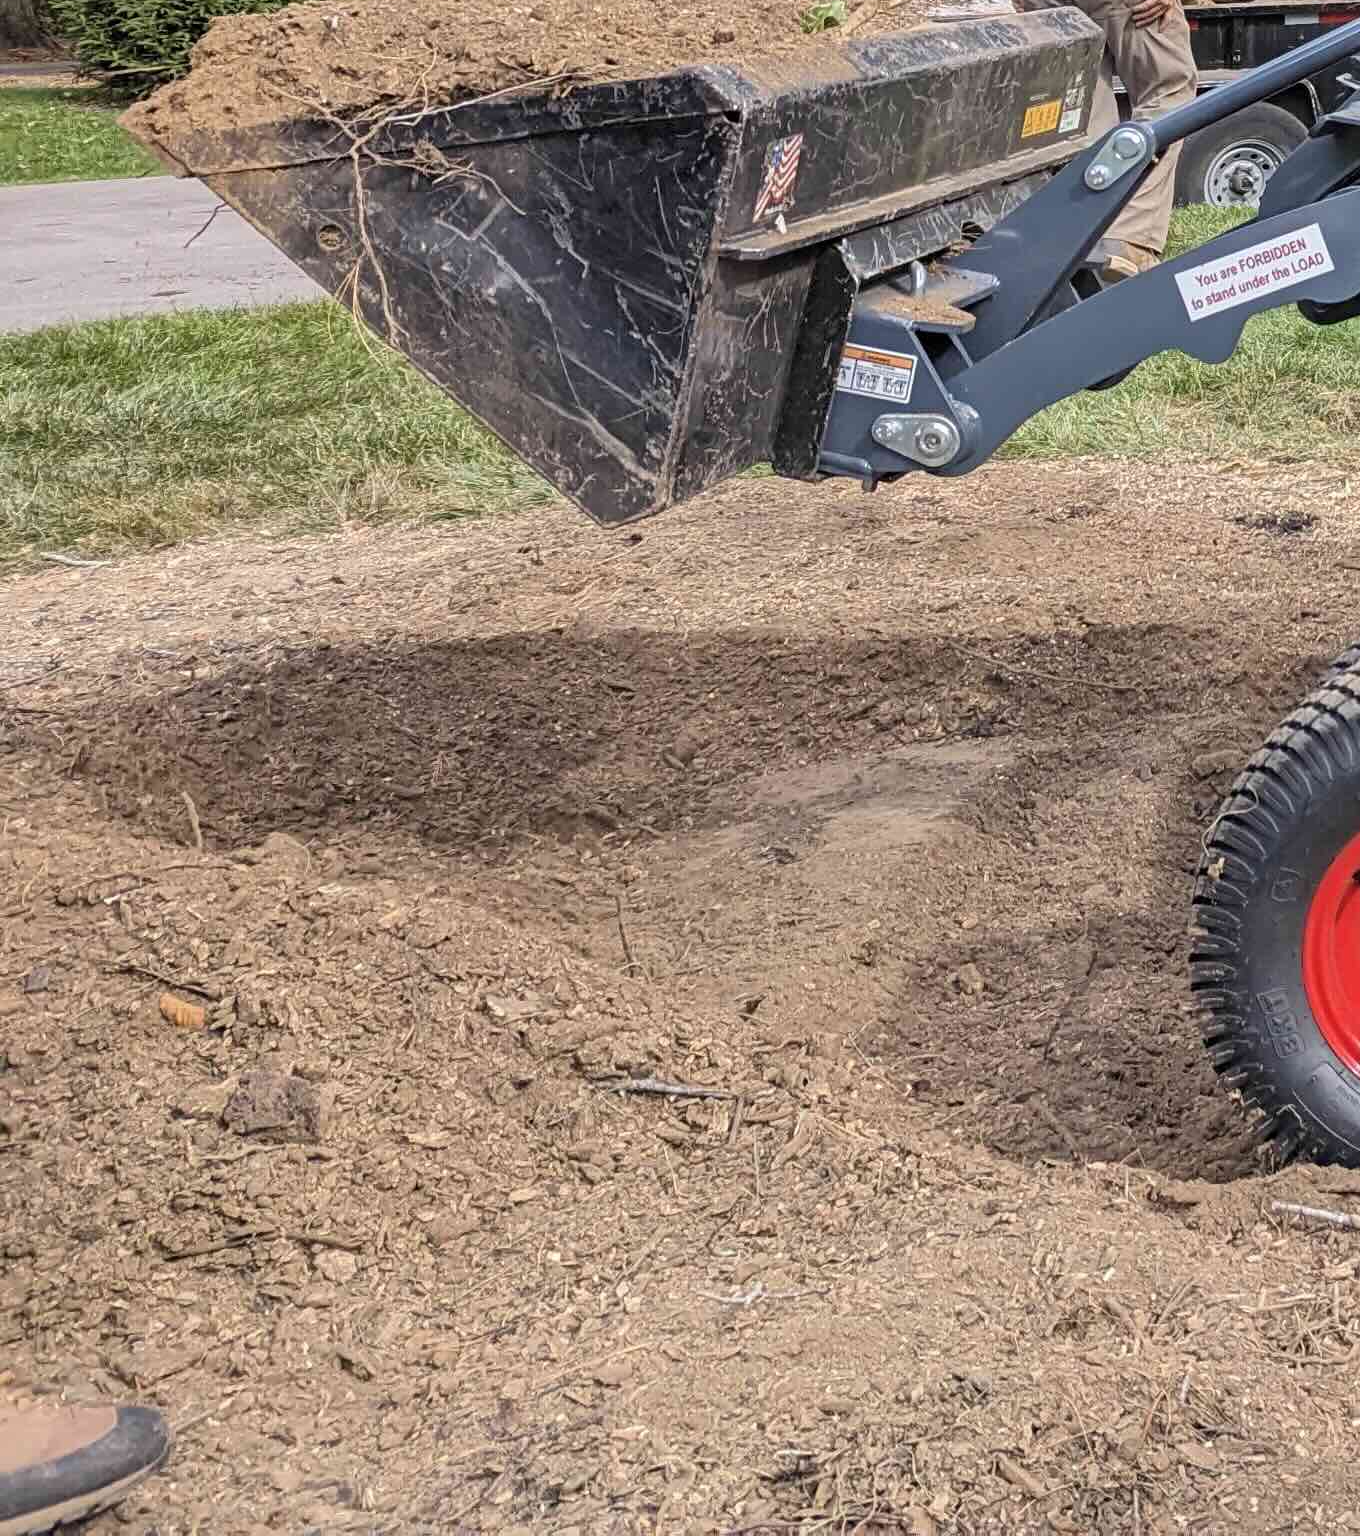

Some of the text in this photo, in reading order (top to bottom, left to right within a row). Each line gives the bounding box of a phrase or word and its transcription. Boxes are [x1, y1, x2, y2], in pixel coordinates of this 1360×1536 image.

[1191, 252, 1325, 311] to stand under the LOAD
[1194, 237, 1307, 288] You are FORBIDDEN
